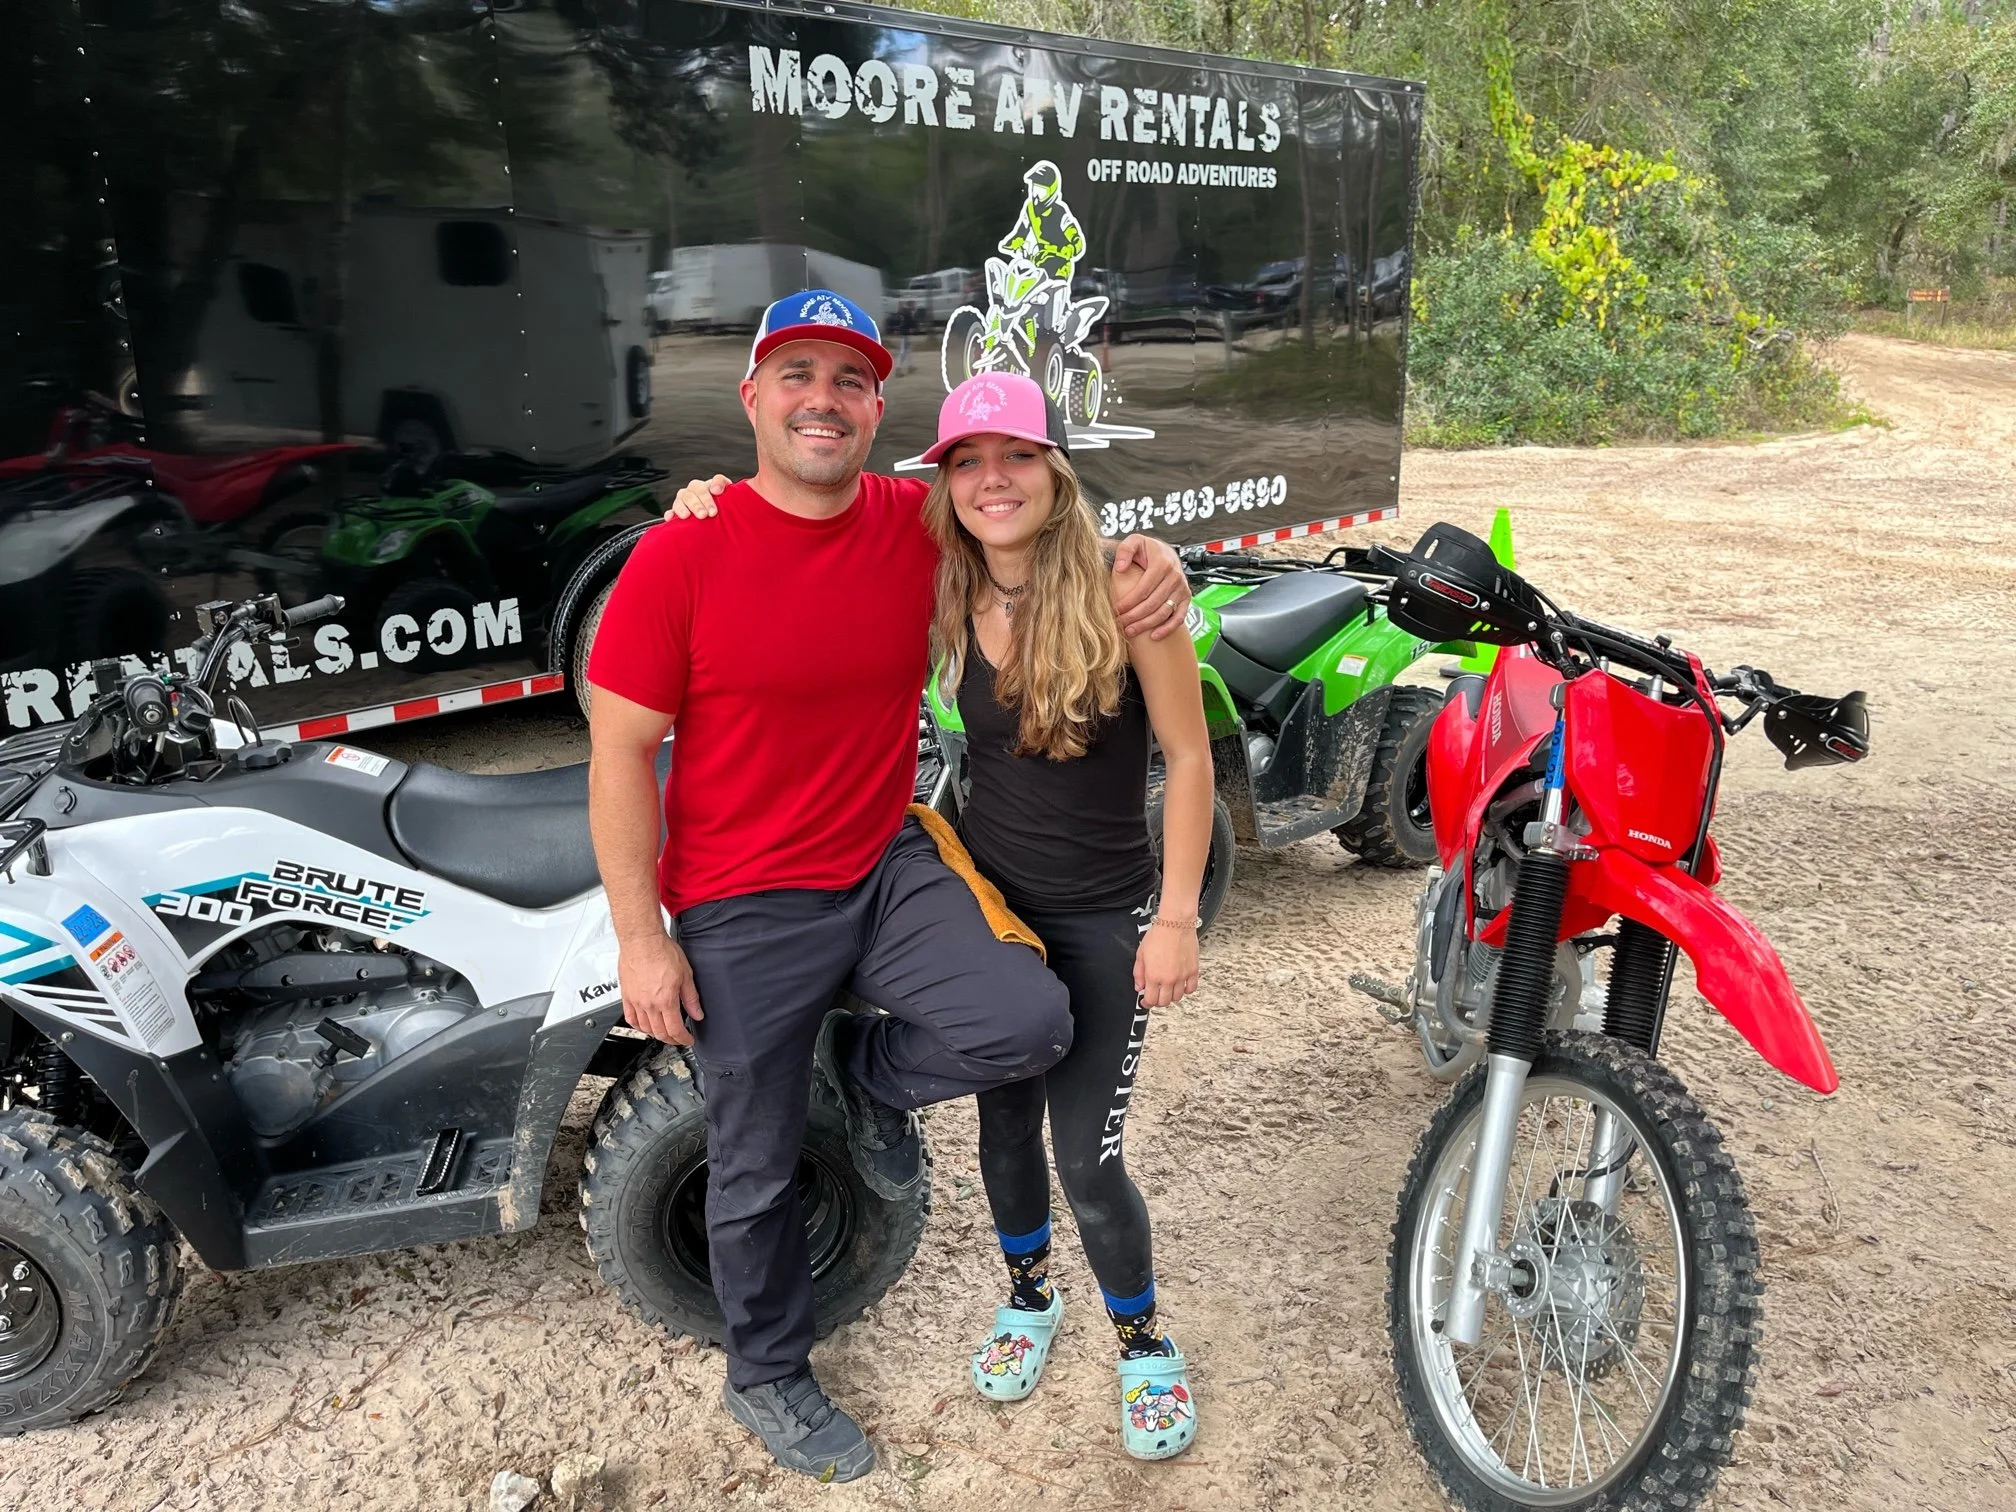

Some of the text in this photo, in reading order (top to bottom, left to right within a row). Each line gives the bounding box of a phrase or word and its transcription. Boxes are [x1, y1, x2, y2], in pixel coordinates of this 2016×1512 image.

[749, 45, 1281, 153] MOORE ATV RENTALS
[1087, 158, 1278, 188] OFF ROAD ADVENTURES
[1492, 689, 1503, 749] HONDA
[1627, 828, 1672, 850] HONDA
[155, 879, 391, 931] 300 FORCE
[272, 859, 426, 911] BRUTE
